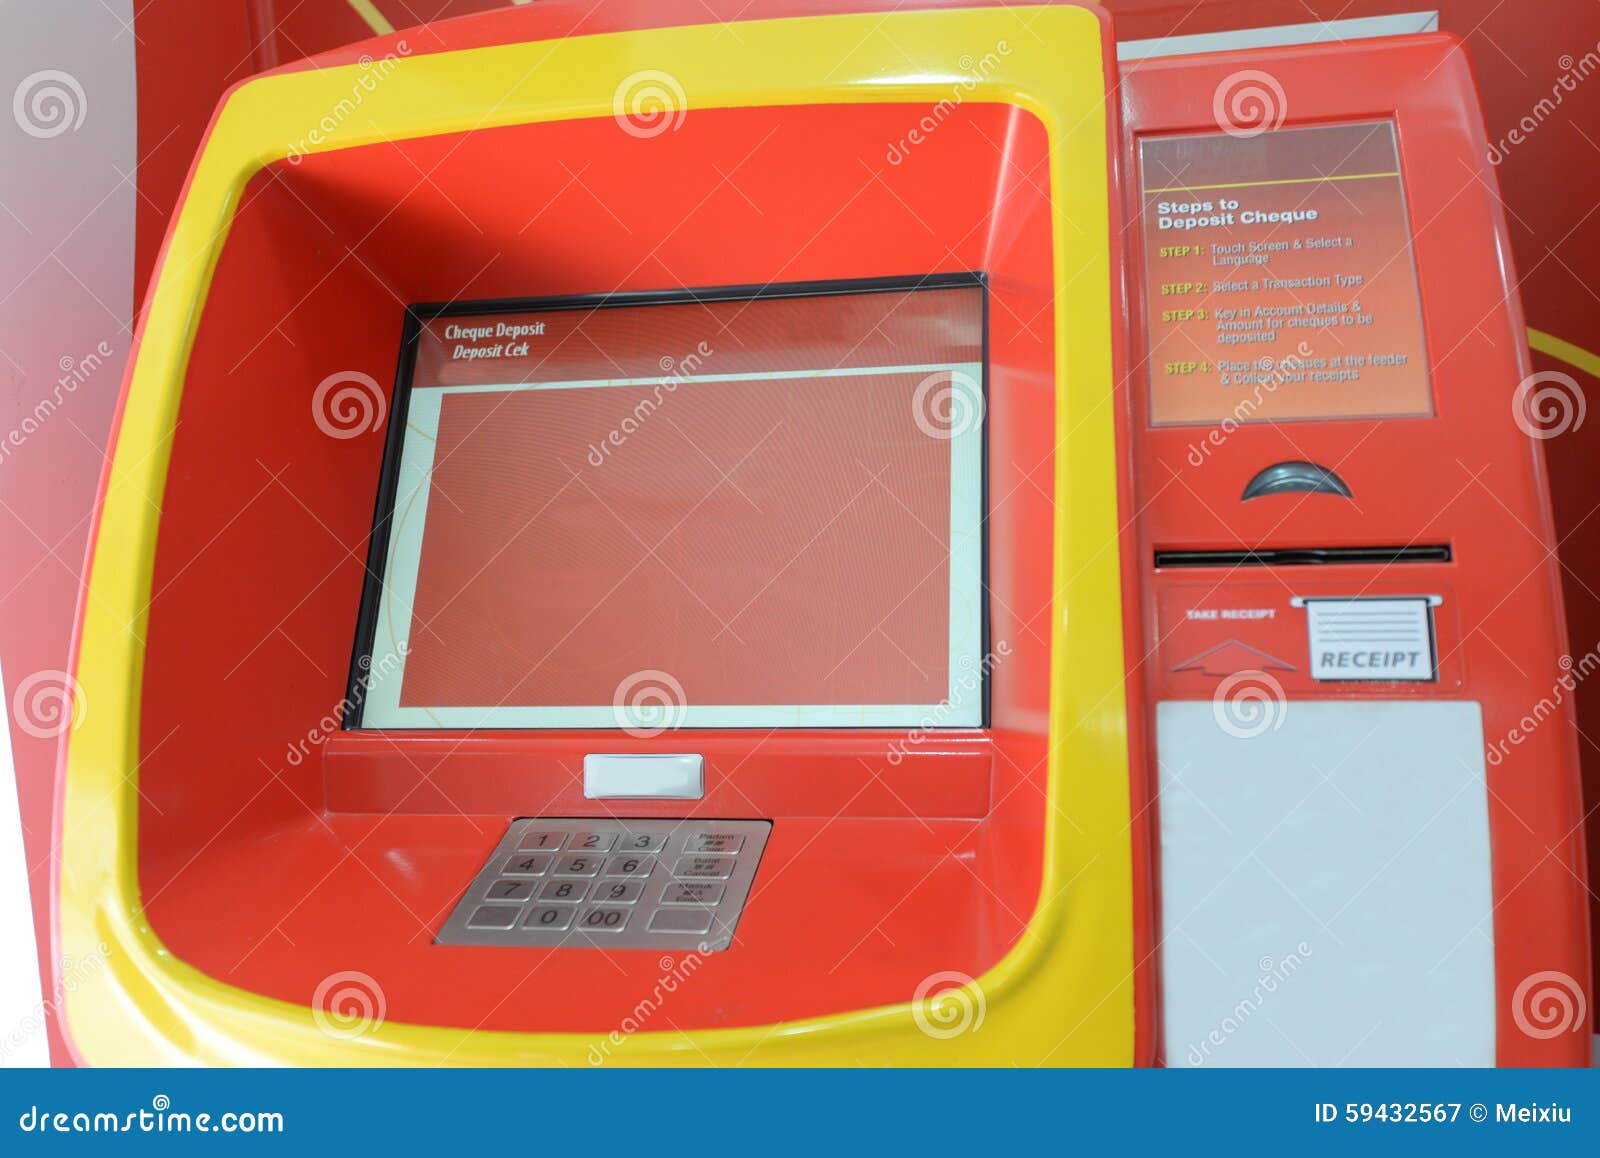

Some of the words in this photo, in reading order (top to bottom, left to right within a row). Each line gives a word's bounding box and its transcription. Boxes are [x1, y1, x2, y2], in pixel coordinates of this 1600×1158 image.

[1157, 199, 1213, 215] Steps
[1220, 199, 1239, 212] to
[1158, 212, 1235, 230] Deposit
[1240, 209, 1318, 225] Cheque
[1160, 246, 1191, 258] STEP
[1212, 242, 1245, 255] Touch
[1248, 240, 1289, 253] Screen
[1294, 239, 1303, 250] &
[1306, 237, 1343, 250] Select
[1345, 238, 1353, 248] a
[1213, 253, 1270, 267] Language
[1161, 284, 1193, 296] STEP
[1212, 280, 1249, 293] Select
[1252, 281, 1259, 291] a
[1263, 276, 1331, 290] Transaction
[1334, 273, 1364, 288] Type
[1162, 310, 1195, 323] STEP
[1215, 308, 1238, 321] Key
[1241, 307, 1252, 318] in
[1256, 304, 1304, 317] Account
[1307, 301, 1350, 315] Details
[1352, 301, 1362, 313] &
[1217, 320, 1265, 332] Amount
[1267, 318, 1285, 330] for
[1288, 315, 1339, 330] cheques
[1341, 314, 1354, 326] to
[1358, 313, 1373, 325] be
[445, 324, 494, 342] Cheque
[496, 321, 546, 340] Deposit
[1217, 331, 1277, 345] deposited
[452, 344, 503, 362] Deposit
[504, 341, 530, 357] Cek
[1164, 362, 1198, 376] STEP
[1217, 360, 1251, 372] Place
[1330, 356, 1344, 368] at
[1345, 354, 1366, 368] the
[1368, 353, 1408, 366] feeder
[1310, 368, 1360, 383] receipts
[1186, 609, 1218, 620] TAKE
[1221, 608, 1277, 620] RECEIPT
[1320, 651, 1421, 669] RECEIPT
[537, 835, 548, 847] 1
[582, 835, 601, 848] 2
[634, 835, 651, 848] 3
[518, 858, 536, 871] 4
[569, 858, 587, 872] 5
[622, 859, 640, 873] 6
[503, 883, 522, 897] 7
[555, 883, 573, 897] 8
[609, 885, 627, 898] 9
[540, 910, 560, 924] 0
[586, 911, 622, 926] 00
